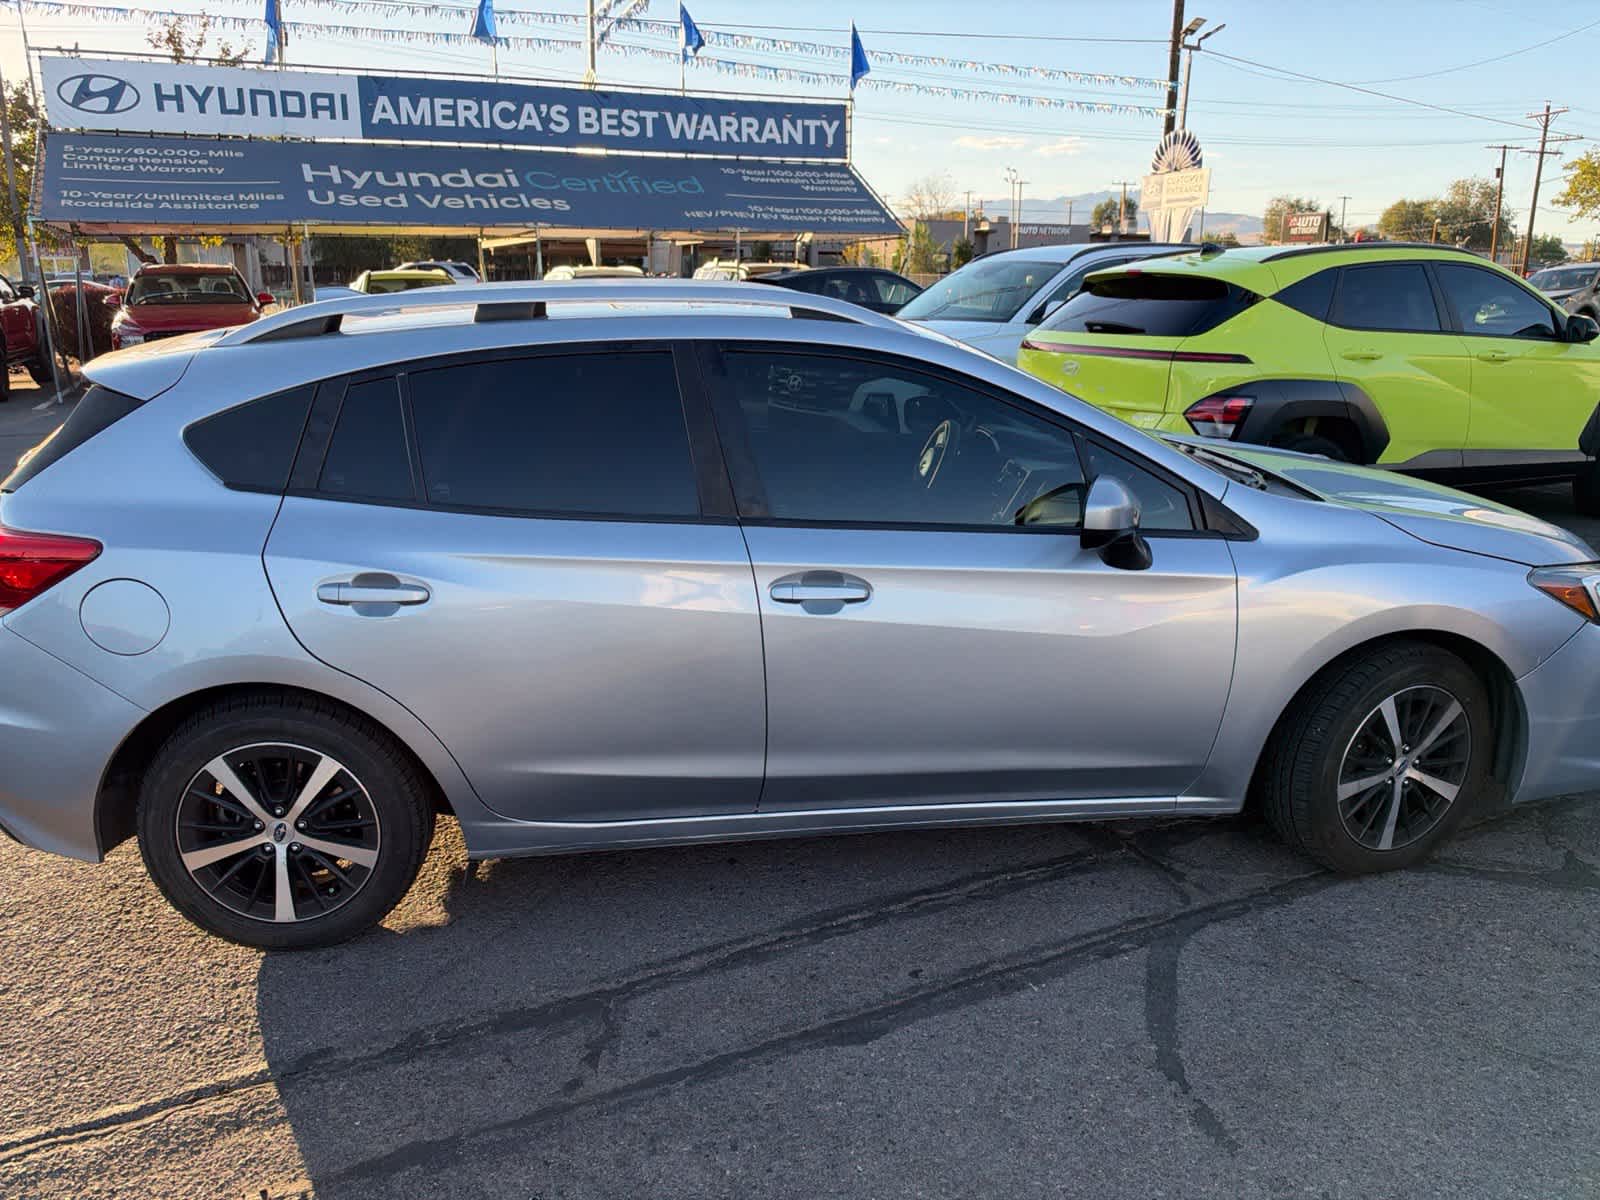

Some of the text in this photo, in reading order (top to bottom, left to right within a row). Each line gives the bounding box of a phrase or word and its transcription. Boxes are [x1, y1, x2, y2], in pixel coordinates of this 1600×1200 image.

[153, 83, 350, 121] HYUNDAI
[578, 106, 660, 138] BEST
[669, 111, 840, 146] WARRANTY
[62, 153, 209, 165] Comprehensive
[62, 160, 226, 176] Limited Warranty
[302, 163, 704, 193] Hyundai Certified
[60, 190, 286, 202] 10-Year/Unlimited Miles
[800, 184, 858, 194] Warranty
[60, 199, 260, 211] Roadside Assistance
[307, 190, 571, 211] Used Vehicles
